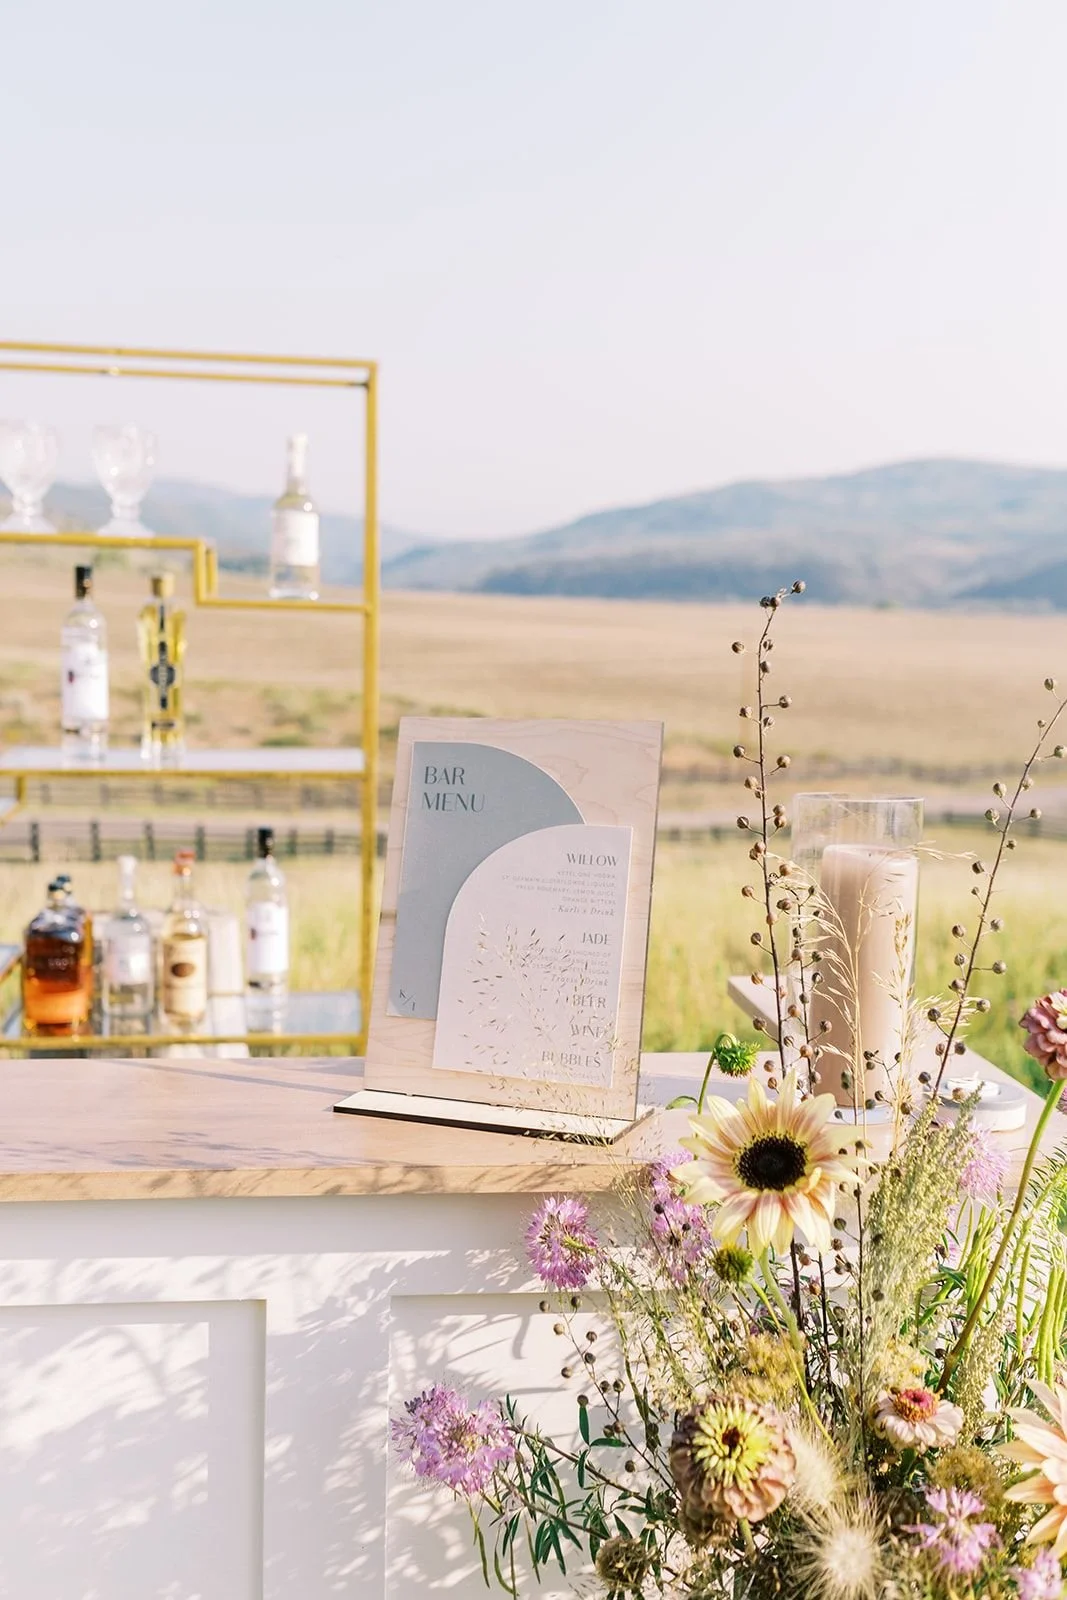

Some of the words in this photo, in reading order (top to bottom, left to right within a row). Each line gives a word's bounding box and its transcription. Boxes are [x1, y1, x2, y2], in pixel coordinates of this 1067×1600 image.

[424, 765, 465, 785] BAR
[422, 791, 485, 813] MENU
[566, 852, 617, 867] WILLOW
[581, 931, 610, 946] JADE
[541, 1050, 602, 1068] BUBBLES
